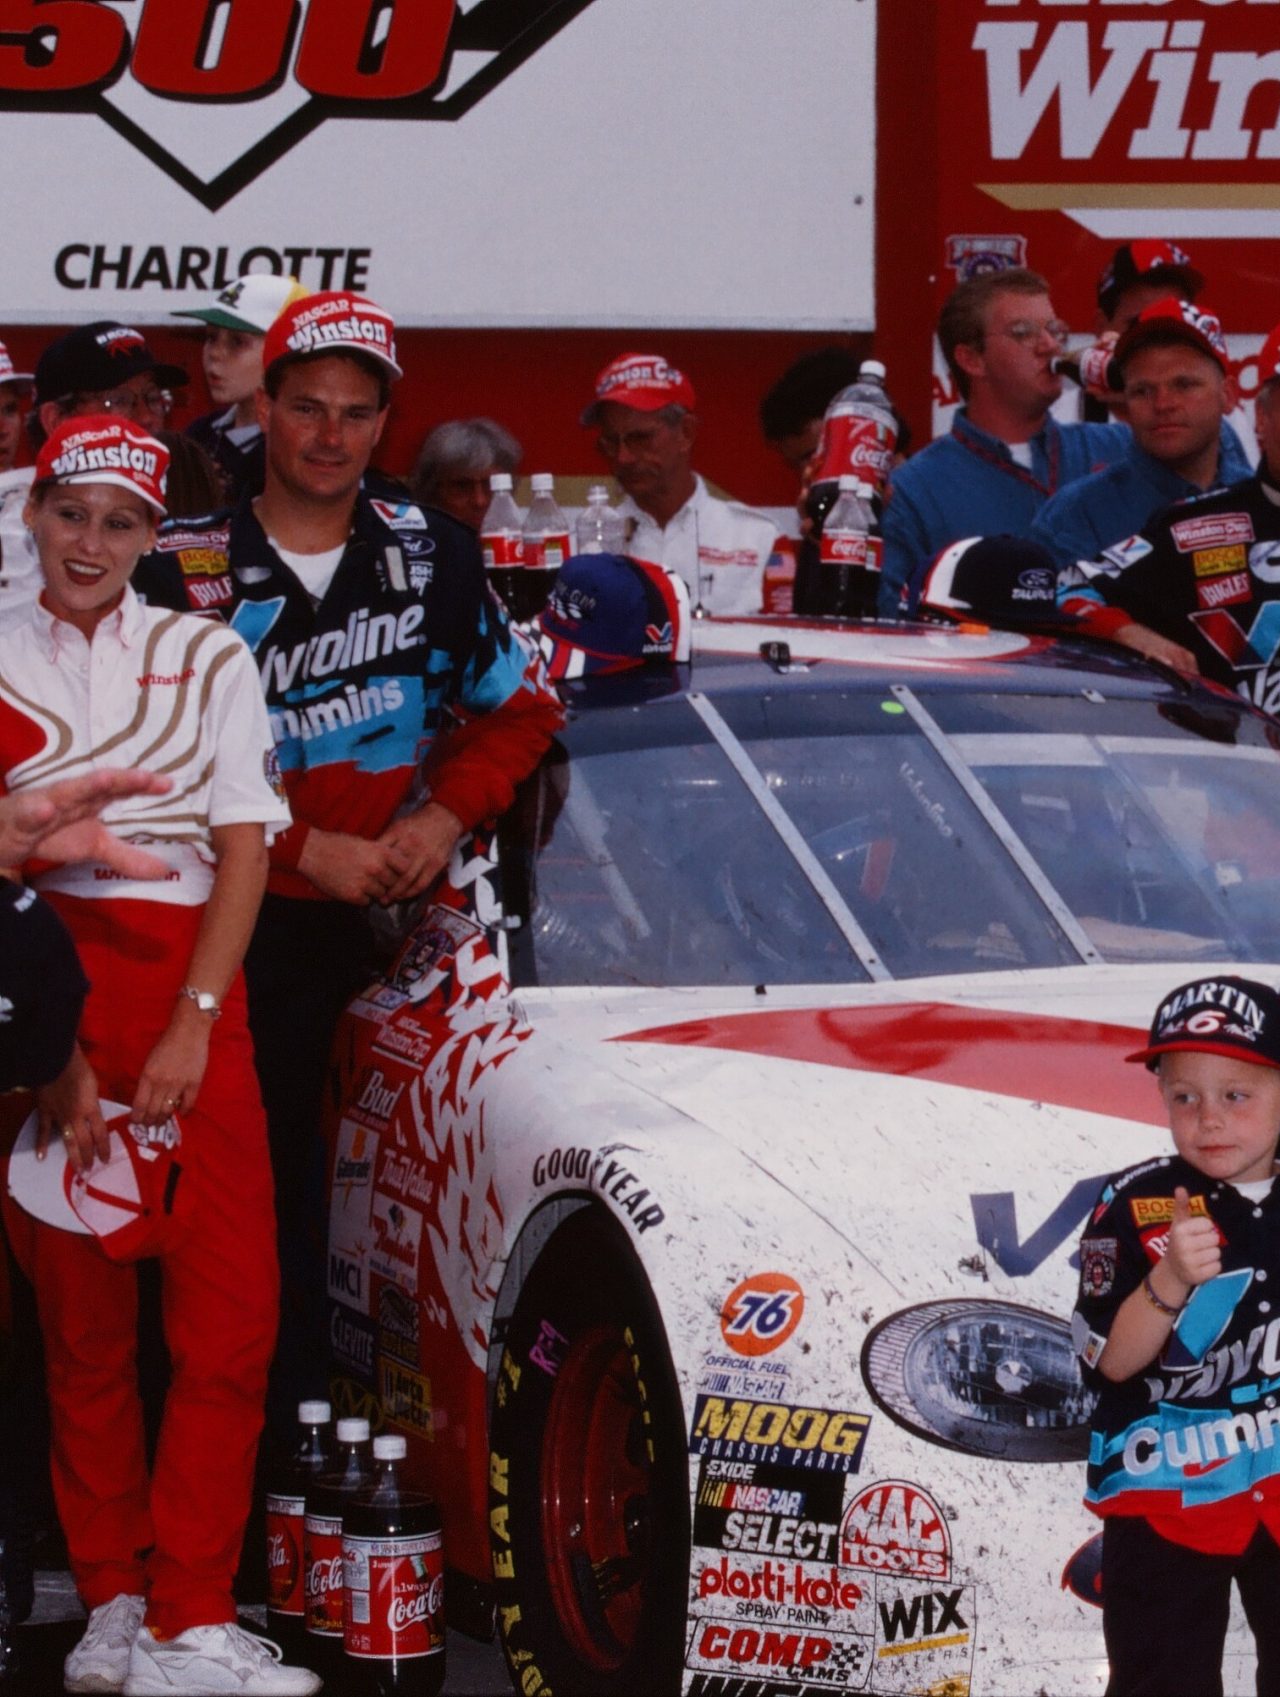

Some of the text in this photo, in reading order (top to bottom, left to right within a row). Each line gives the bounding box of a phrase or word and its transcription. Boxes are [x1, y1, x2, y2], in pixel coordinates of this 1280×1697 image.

[54, 243, 372, 292] CHARLOTTE
[292, 300, 350, 329] NASCAR
[286, 315, 388, 354] Winston
[62, 425, 121, 450] NASCAR
[51, 442, 158, 476] Winston
[258, 603, 425, 698] lvoline
[135, 667, 196, 689] Winston
[1158, 982, 1265, 1034] MARTIN
[1187, 1010, 1226, 1034] 6
[357, 1069, 406, 1120] Bud
[1136, 1201, 1202, 1217] BOSH
[329, 1255, 361, 1300] MCI
[726, 1290, 800, 1338] 76
[706, 1355, 790, 1375] OFFICIAL FUEL
[694, 1397, 871, 1456] MOOG
[699, 1437, 852, 1473] CHASSIS PARTS
[705, 1459, 757, 1480] EXIDE
[731, 1486, 805, 1517] NASCAR
[850, 1487, 948, 1552] MAC
[721, 1511, 838, 1560] SELECT
[843, 1543, 946, 1576] TOOLS
[699, 1556, 863, 1610] plasti-kote
[735, 1601, 829, 1626] SPRAY PAINT
[878, 1588, 969, 1643] WIX
[698, 1624, 834, 1668] COMP
[786, 1662, 851, 1683] CAMS
